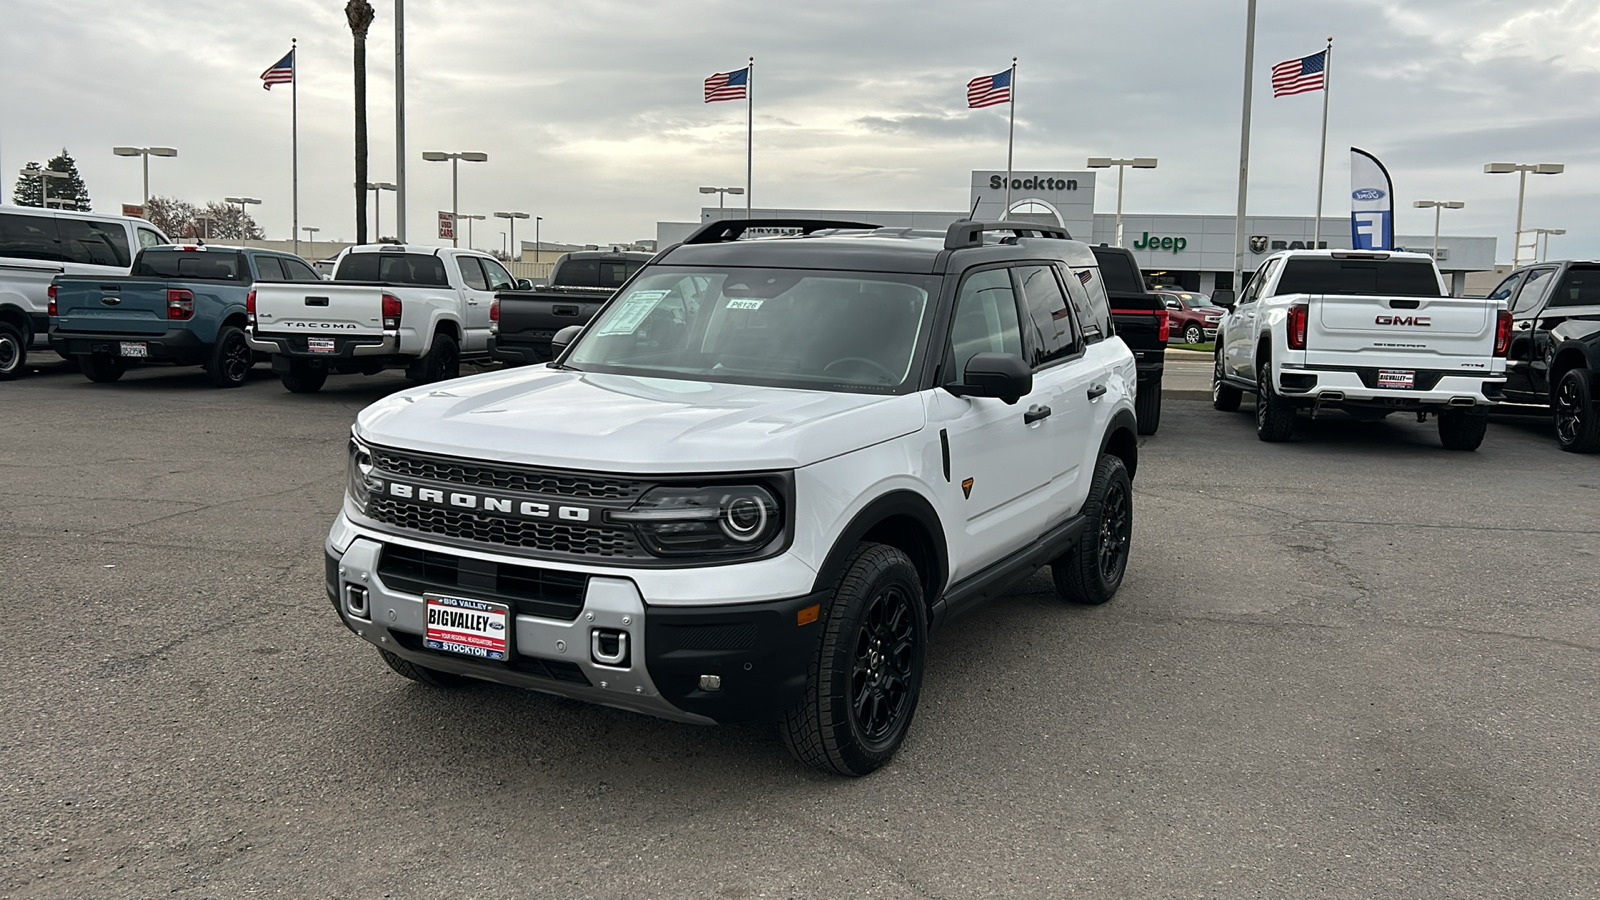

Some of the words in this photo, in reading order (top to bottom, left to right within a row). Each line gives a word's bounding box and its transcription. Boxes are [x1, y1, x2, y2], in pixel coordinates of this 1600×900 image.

[989, 174, 1078, 191] Stockton
[440, 228, 453, 237] CARS
[1133, 231, 1187, 254] Jeep
[730, 301, 757, 309] P6126
[1375, 315, 1431, 327] GMC
[390, 482, 590, 522] BRONCO
[443, 598, 459, 606] BIG
[459, 600, 488, 610] VALLEY
[428, 608, 490, 632] BIGVALLEY
[442, 642, 488, 657] STOCKTON
